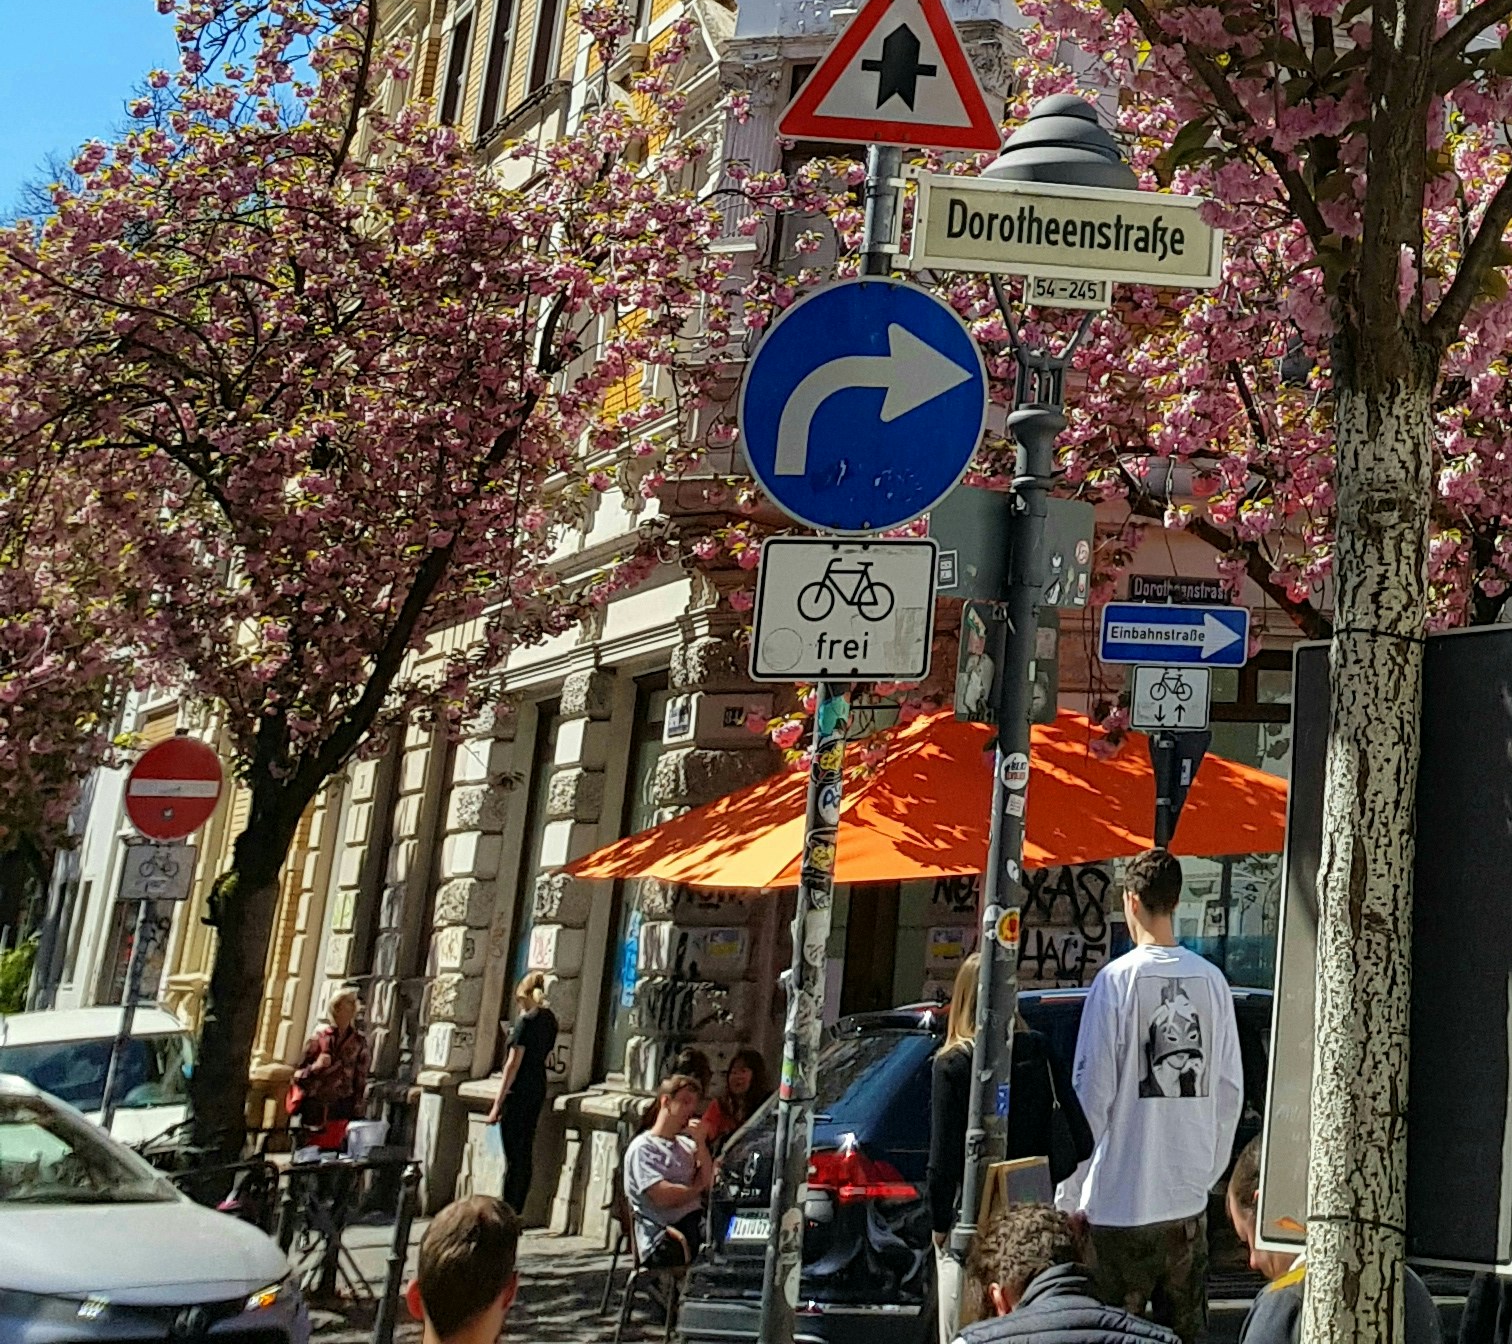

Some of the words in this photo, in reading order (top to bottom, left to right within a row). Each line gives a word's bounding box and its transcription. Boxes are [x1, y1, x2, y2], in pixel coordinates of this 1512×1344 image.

[947, 198, 1185, 261] Dorotheenstraße
[817, 631, 869, 660] frei
[1111, 625, 1205, 643] Einbahnstraße
